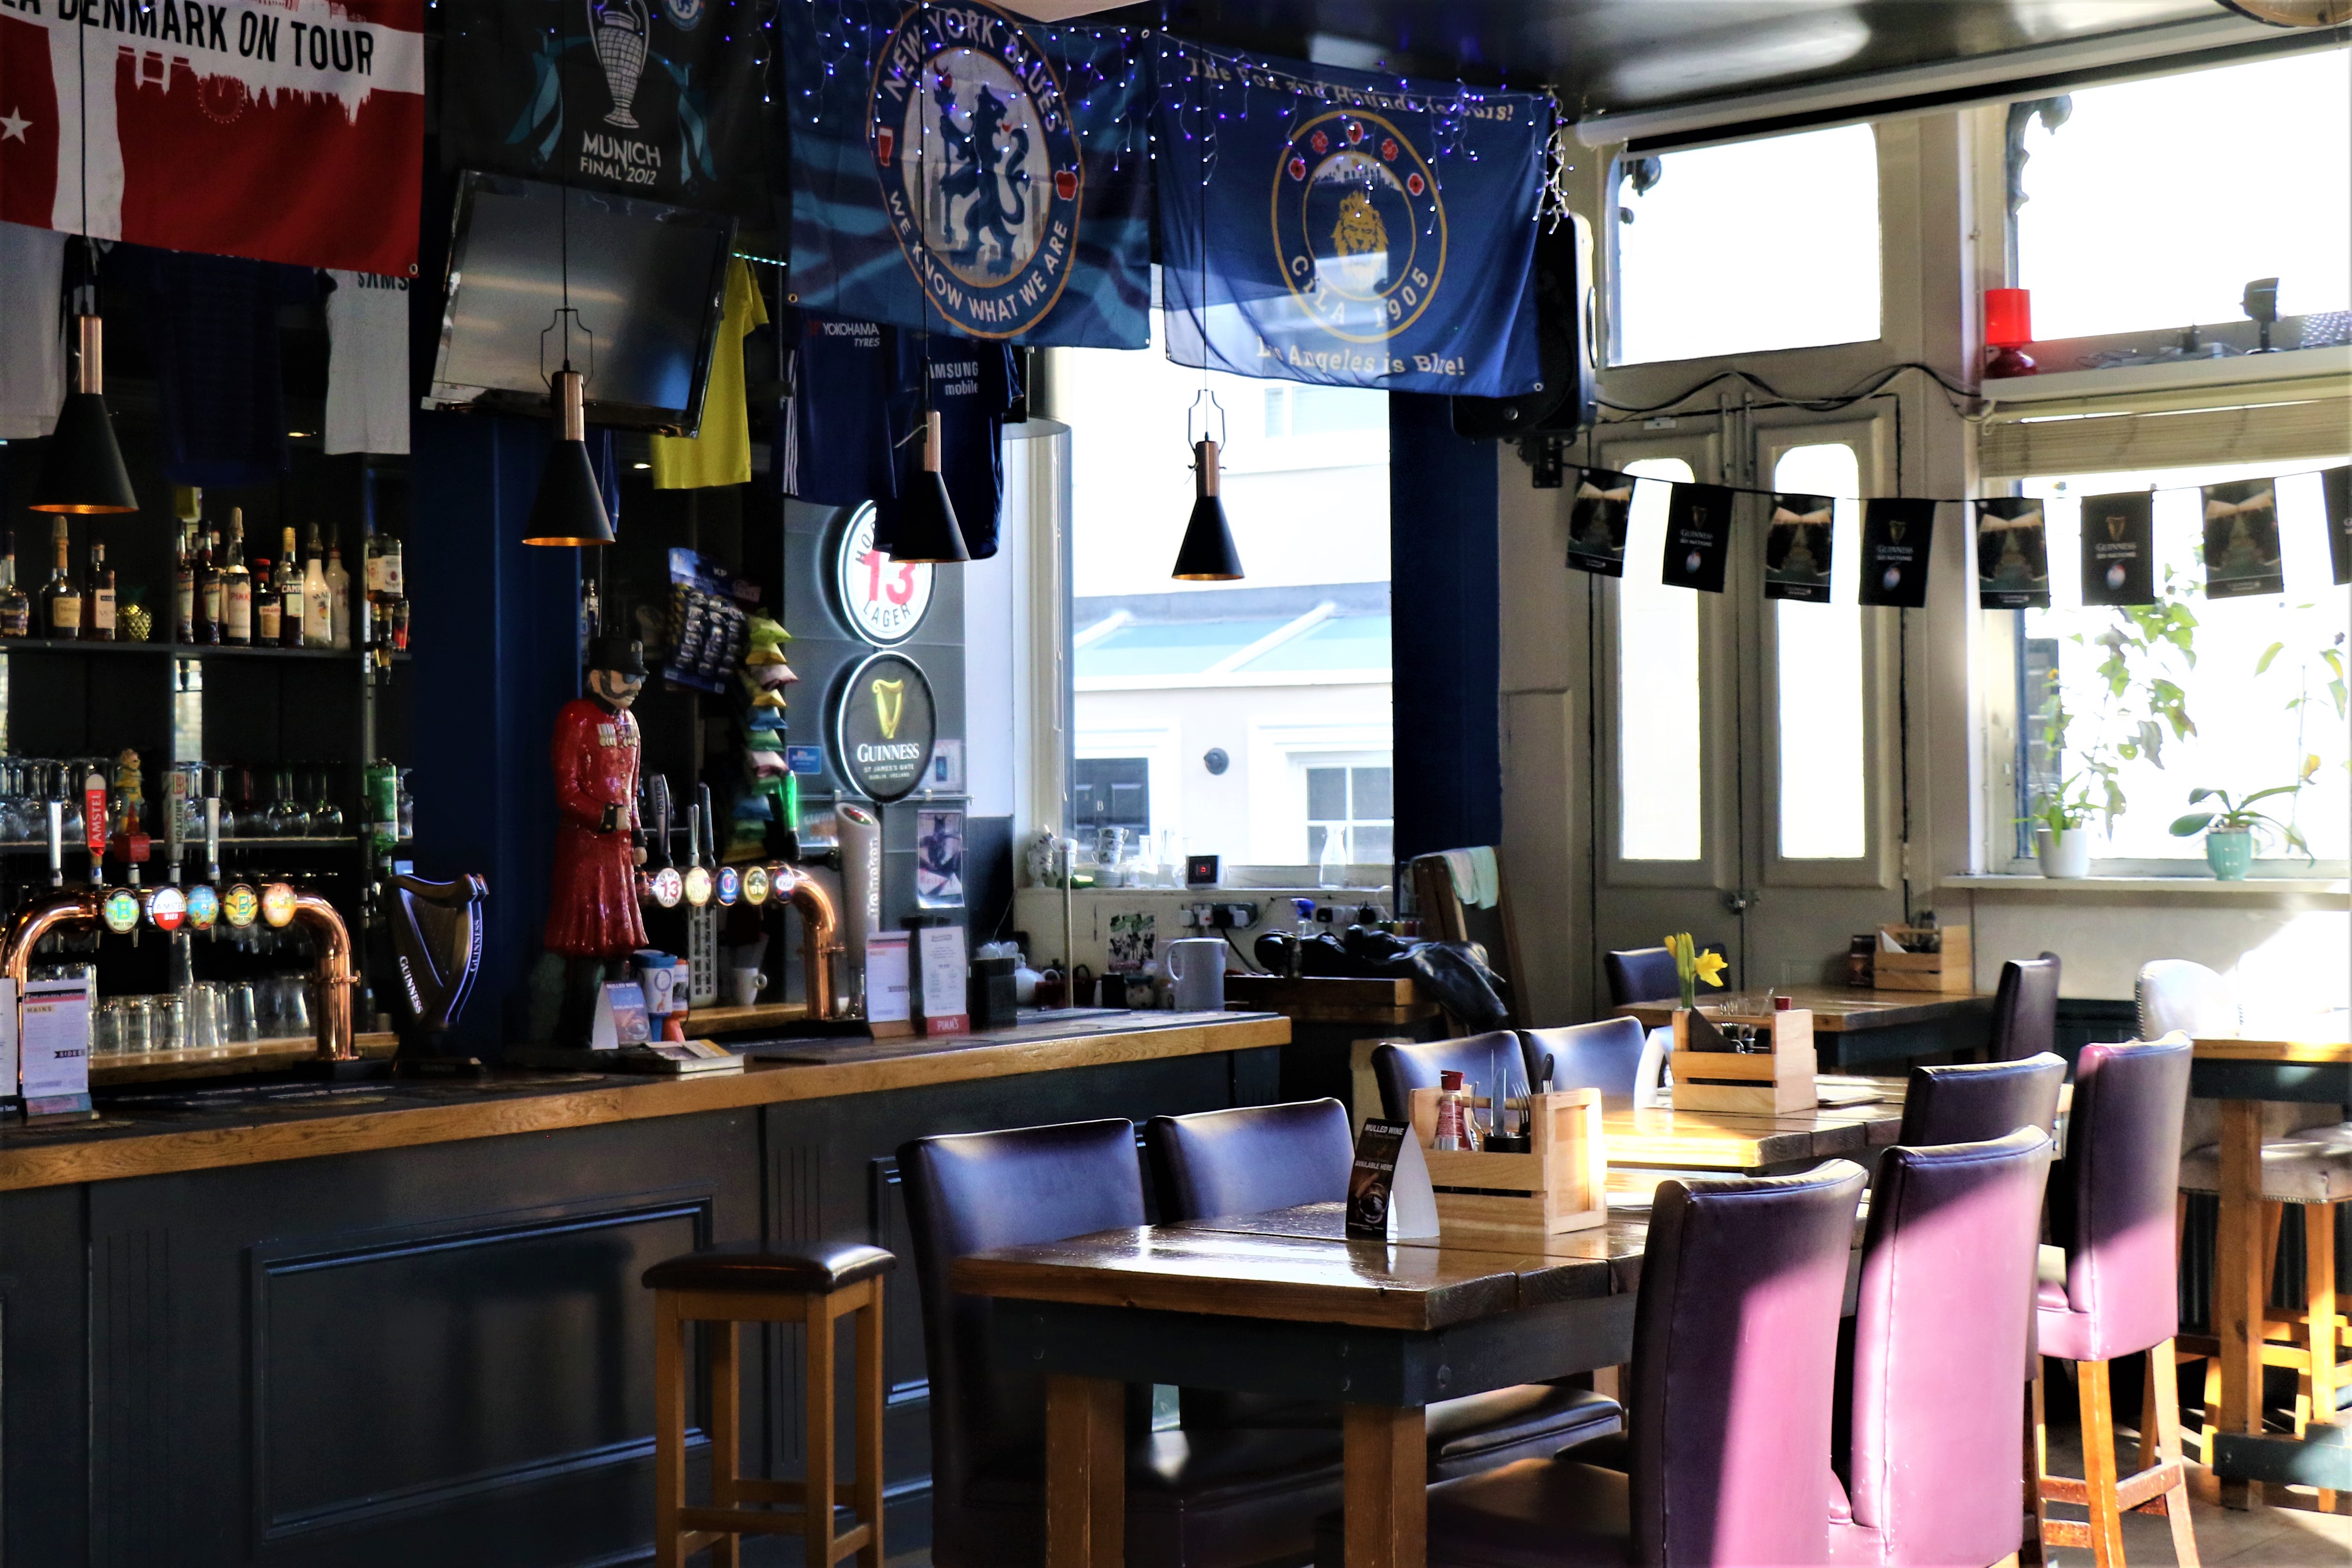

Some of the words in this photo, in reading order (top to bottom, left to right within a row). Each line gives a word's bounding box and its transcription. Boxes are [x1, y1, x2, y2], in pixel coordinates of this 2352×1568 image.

[239, 11, 279, 62] ON
[291, 21, 374, 76] TOUR
[883, 24, 926, 102] NEW
[927, 8, 995, 48] YORK
[1004, 33, 1062, 132] BLUES
[1334, 85, 1420, 113] Hound
[582, 130, 661, 170] MUNICH
[581, 157, 621, 180] FINAL
[626, 167, 657, 185] 2012
[890, 191, 912, 236] WE
[912, 241, 963, 310] KNOW
[968, 294, 1019, 323] WHAT
[1020, 270, 1047, 307] WE
[1044, 220, 1068, 275] ARE
[1373, 267, 1428, 328] 1905
[823, 322, 879, 336] YOKOHAMA
[854, 338, 880, 347] TYRES
[930, 361, 979, 379] AMSUNG
[1289, 344, 1375, 372] Angeles
[1384, 352, 1406, 373] is
[1412, 353, 1466, 376] Blue!
[944, 380, 979, 396] mobile
[862, 550, 915, 605] 13
[863, 599, 910, 627] LAGER
[857, 743, 920, 762] GUINNESS
[92, 792, 102, 842] AMSTEL
[662, 880, 679, 897] 13
[238, 896, 251, 916] B
[469, 919, 480, 972] GUINNESS
[399, 955, 423, 1015] GUINNESS
[938, 1018, 959, 1030] PIMM'S
[1364, 1124, 1388, 1134] MULLED
[1388, 1127, 1405, 1135] WINE
[1354, 1160, 1379, 1169] AVAILABLE
